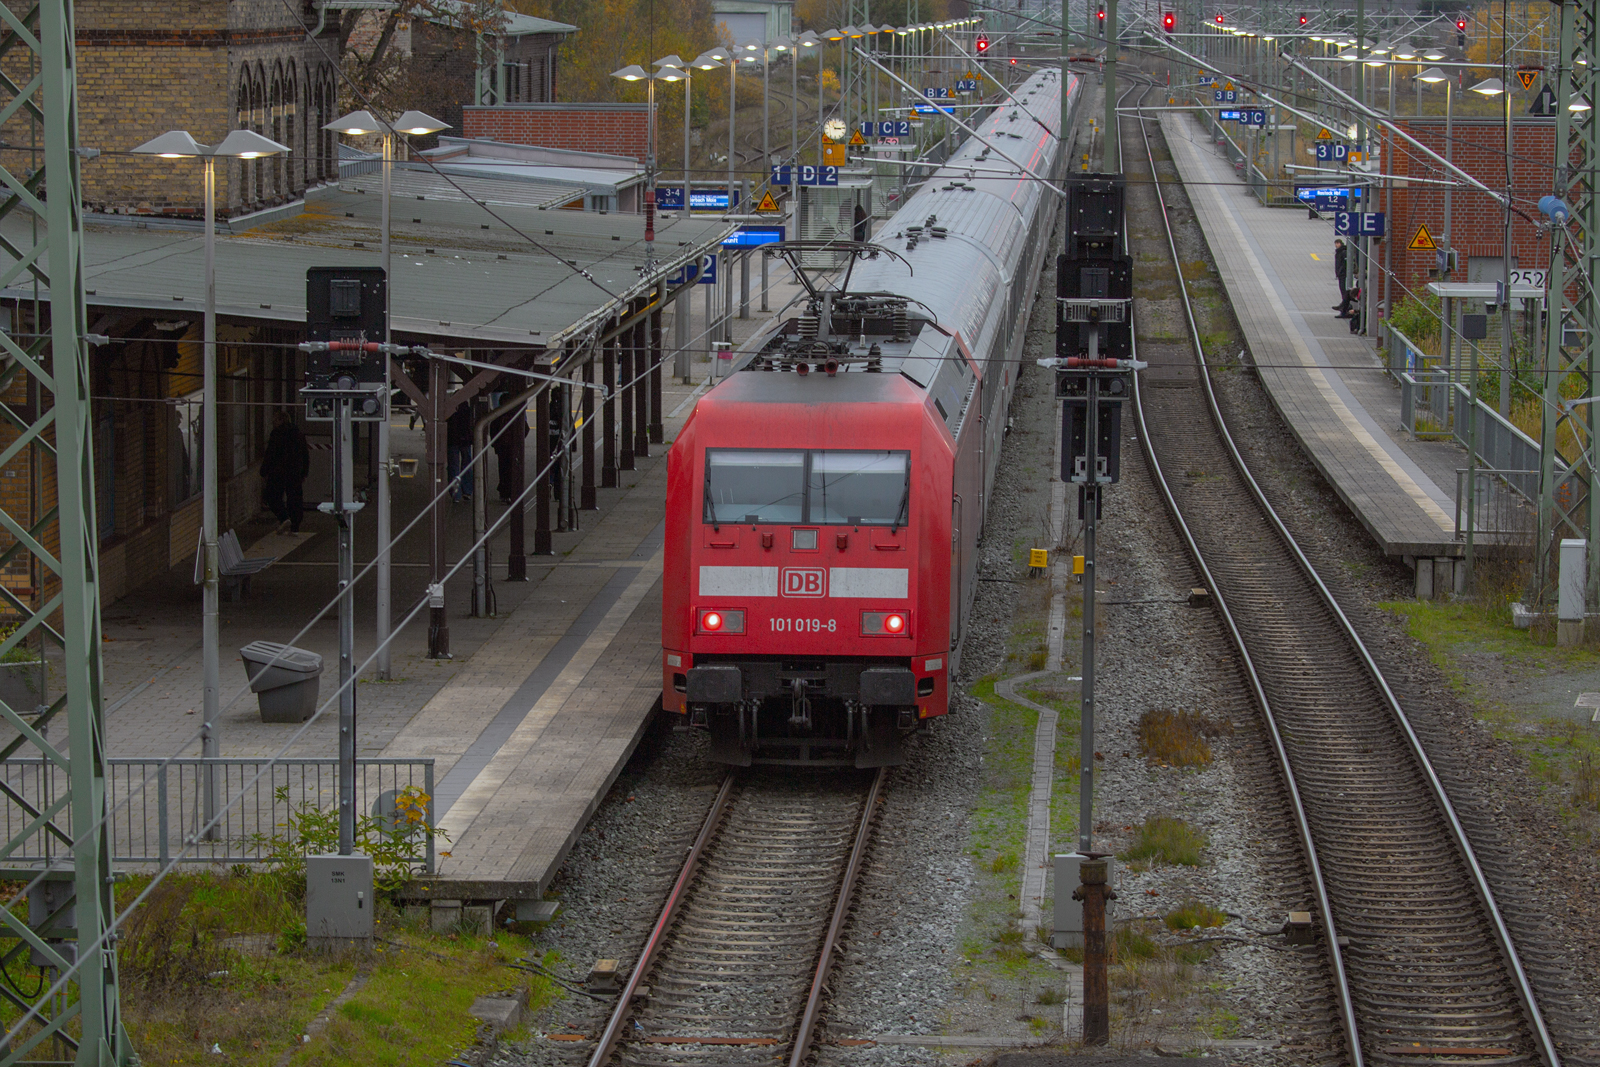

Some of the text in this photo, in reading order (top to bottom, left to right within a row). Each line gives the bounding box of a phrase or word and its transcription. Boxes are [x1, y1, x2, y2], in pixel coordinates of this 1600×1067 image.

[958, 80, 976, 89] A 2
[1524, 74, 1530, 85] 6
[927, 88, 947, 98] B 2
[1216, 91, 1233, 99] 3 B
[1240, 112, 1247, 122] 3
[1254, 112, 1262, 122] C
[861, 122, 908, 133] 1 C 2
[1318, 145, 1345, 158] 3 D
[774, 166, 836, 181] 1 D 2
[665, 188, 680, 197] 3-4
[1338, 212, 1376, 231] 3 E
[702, 255, 713, 277] 2
[1510, 271, 1543, 288] 252
[788, 572, 820, 592] DB
